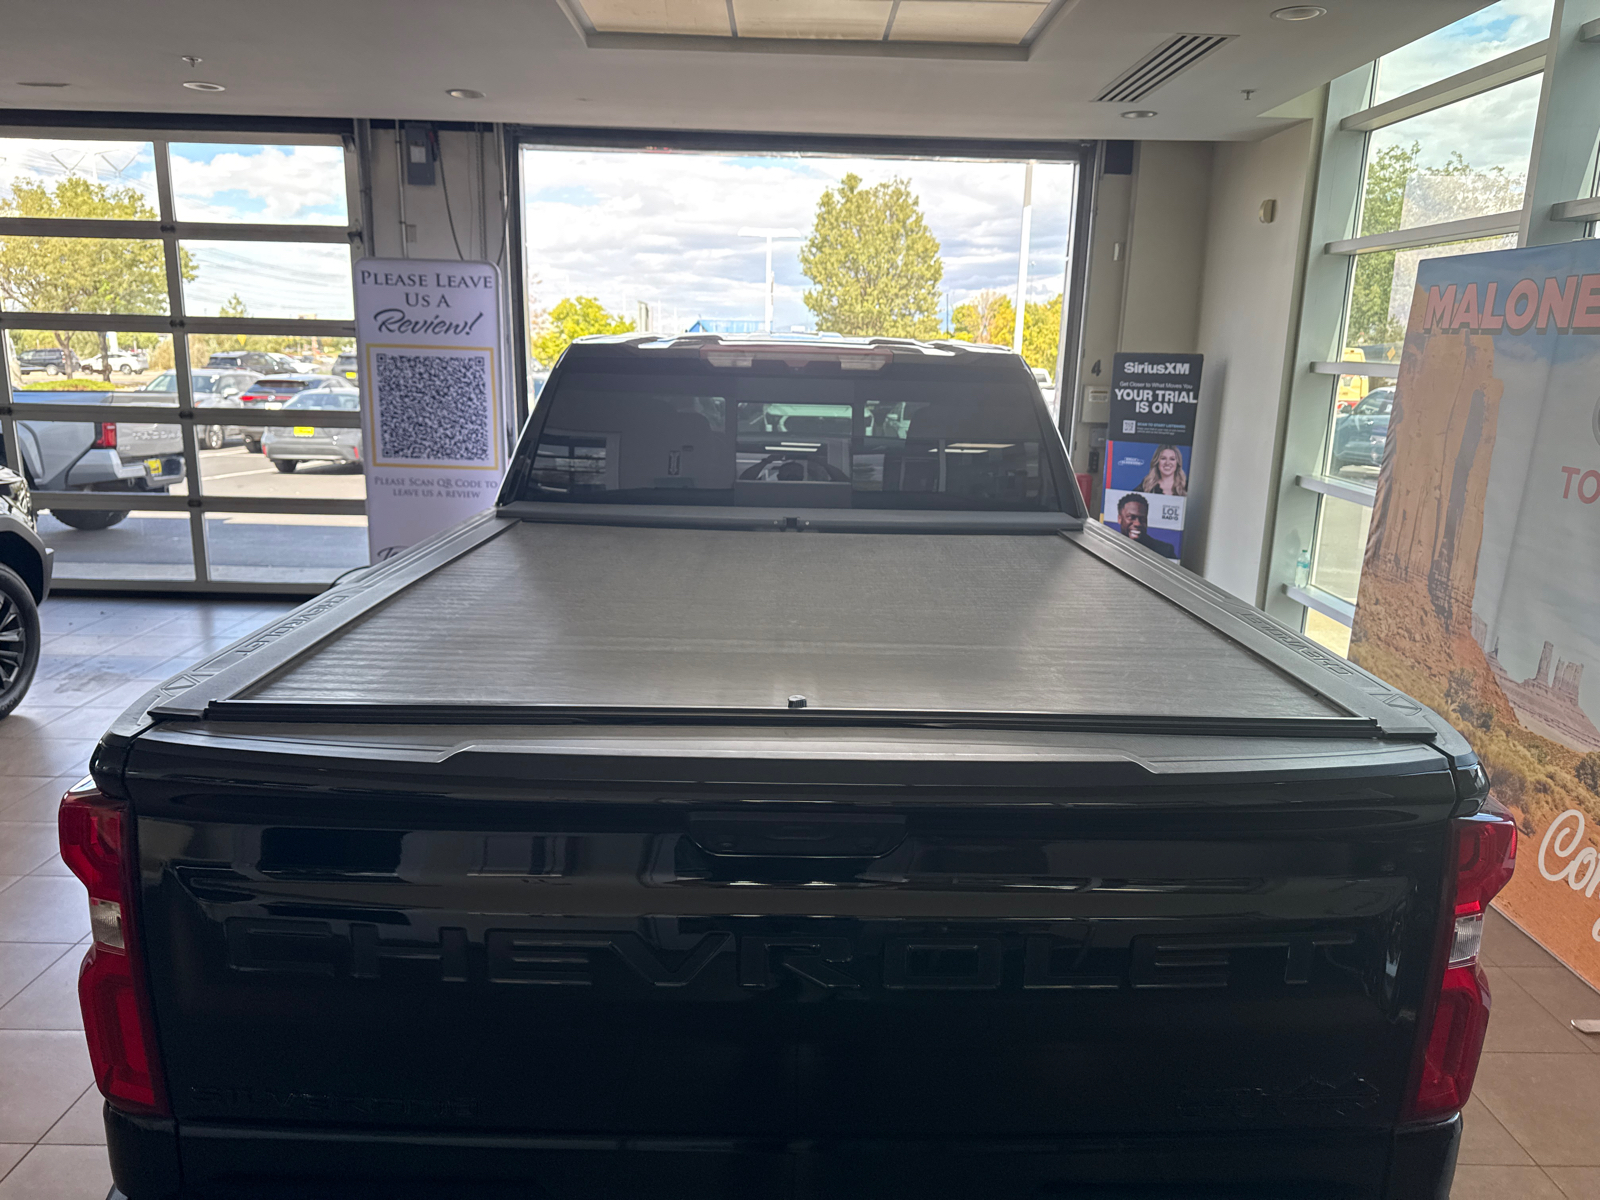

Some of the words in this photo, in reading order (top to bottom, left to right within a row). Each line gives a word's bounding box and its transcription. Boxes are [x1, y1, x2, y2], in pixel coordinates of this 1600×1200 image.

[360, 270, 429, 288] PLEASE
[435, 272, 494, 289] LEAVE
[404, 292, 431, 308] US
[436, 293, 451, 308] A
[1423, 274, 1600, 335] MALONE
[373, 308, 484, 336] Review!
[1091, 359, 1101, 377] 4
[1123, 361, 1190, 375] SiriusXM
[1114, 388, 1153, 402] YOUR
[1155, 390, 1198, 404] TRIAL
[1135, 401, 1149, 413] IS
[1151, 402, 1174, 415] ON
[437, 478, 454, 489] QR
[393, 488, 419, 498] LEAVE
[421, 489, 434, 498] US
[436, 489, 444, 498] A
[445, 490, 481, 499] REVIEW
[1162, 507, 1179, 516] LOL
[235, 595, 350, 657] CHEVROLET
[1237, 611, 1354, 676] CHEVROLET
[224, 916, 1358, 989] CHEVROLET
